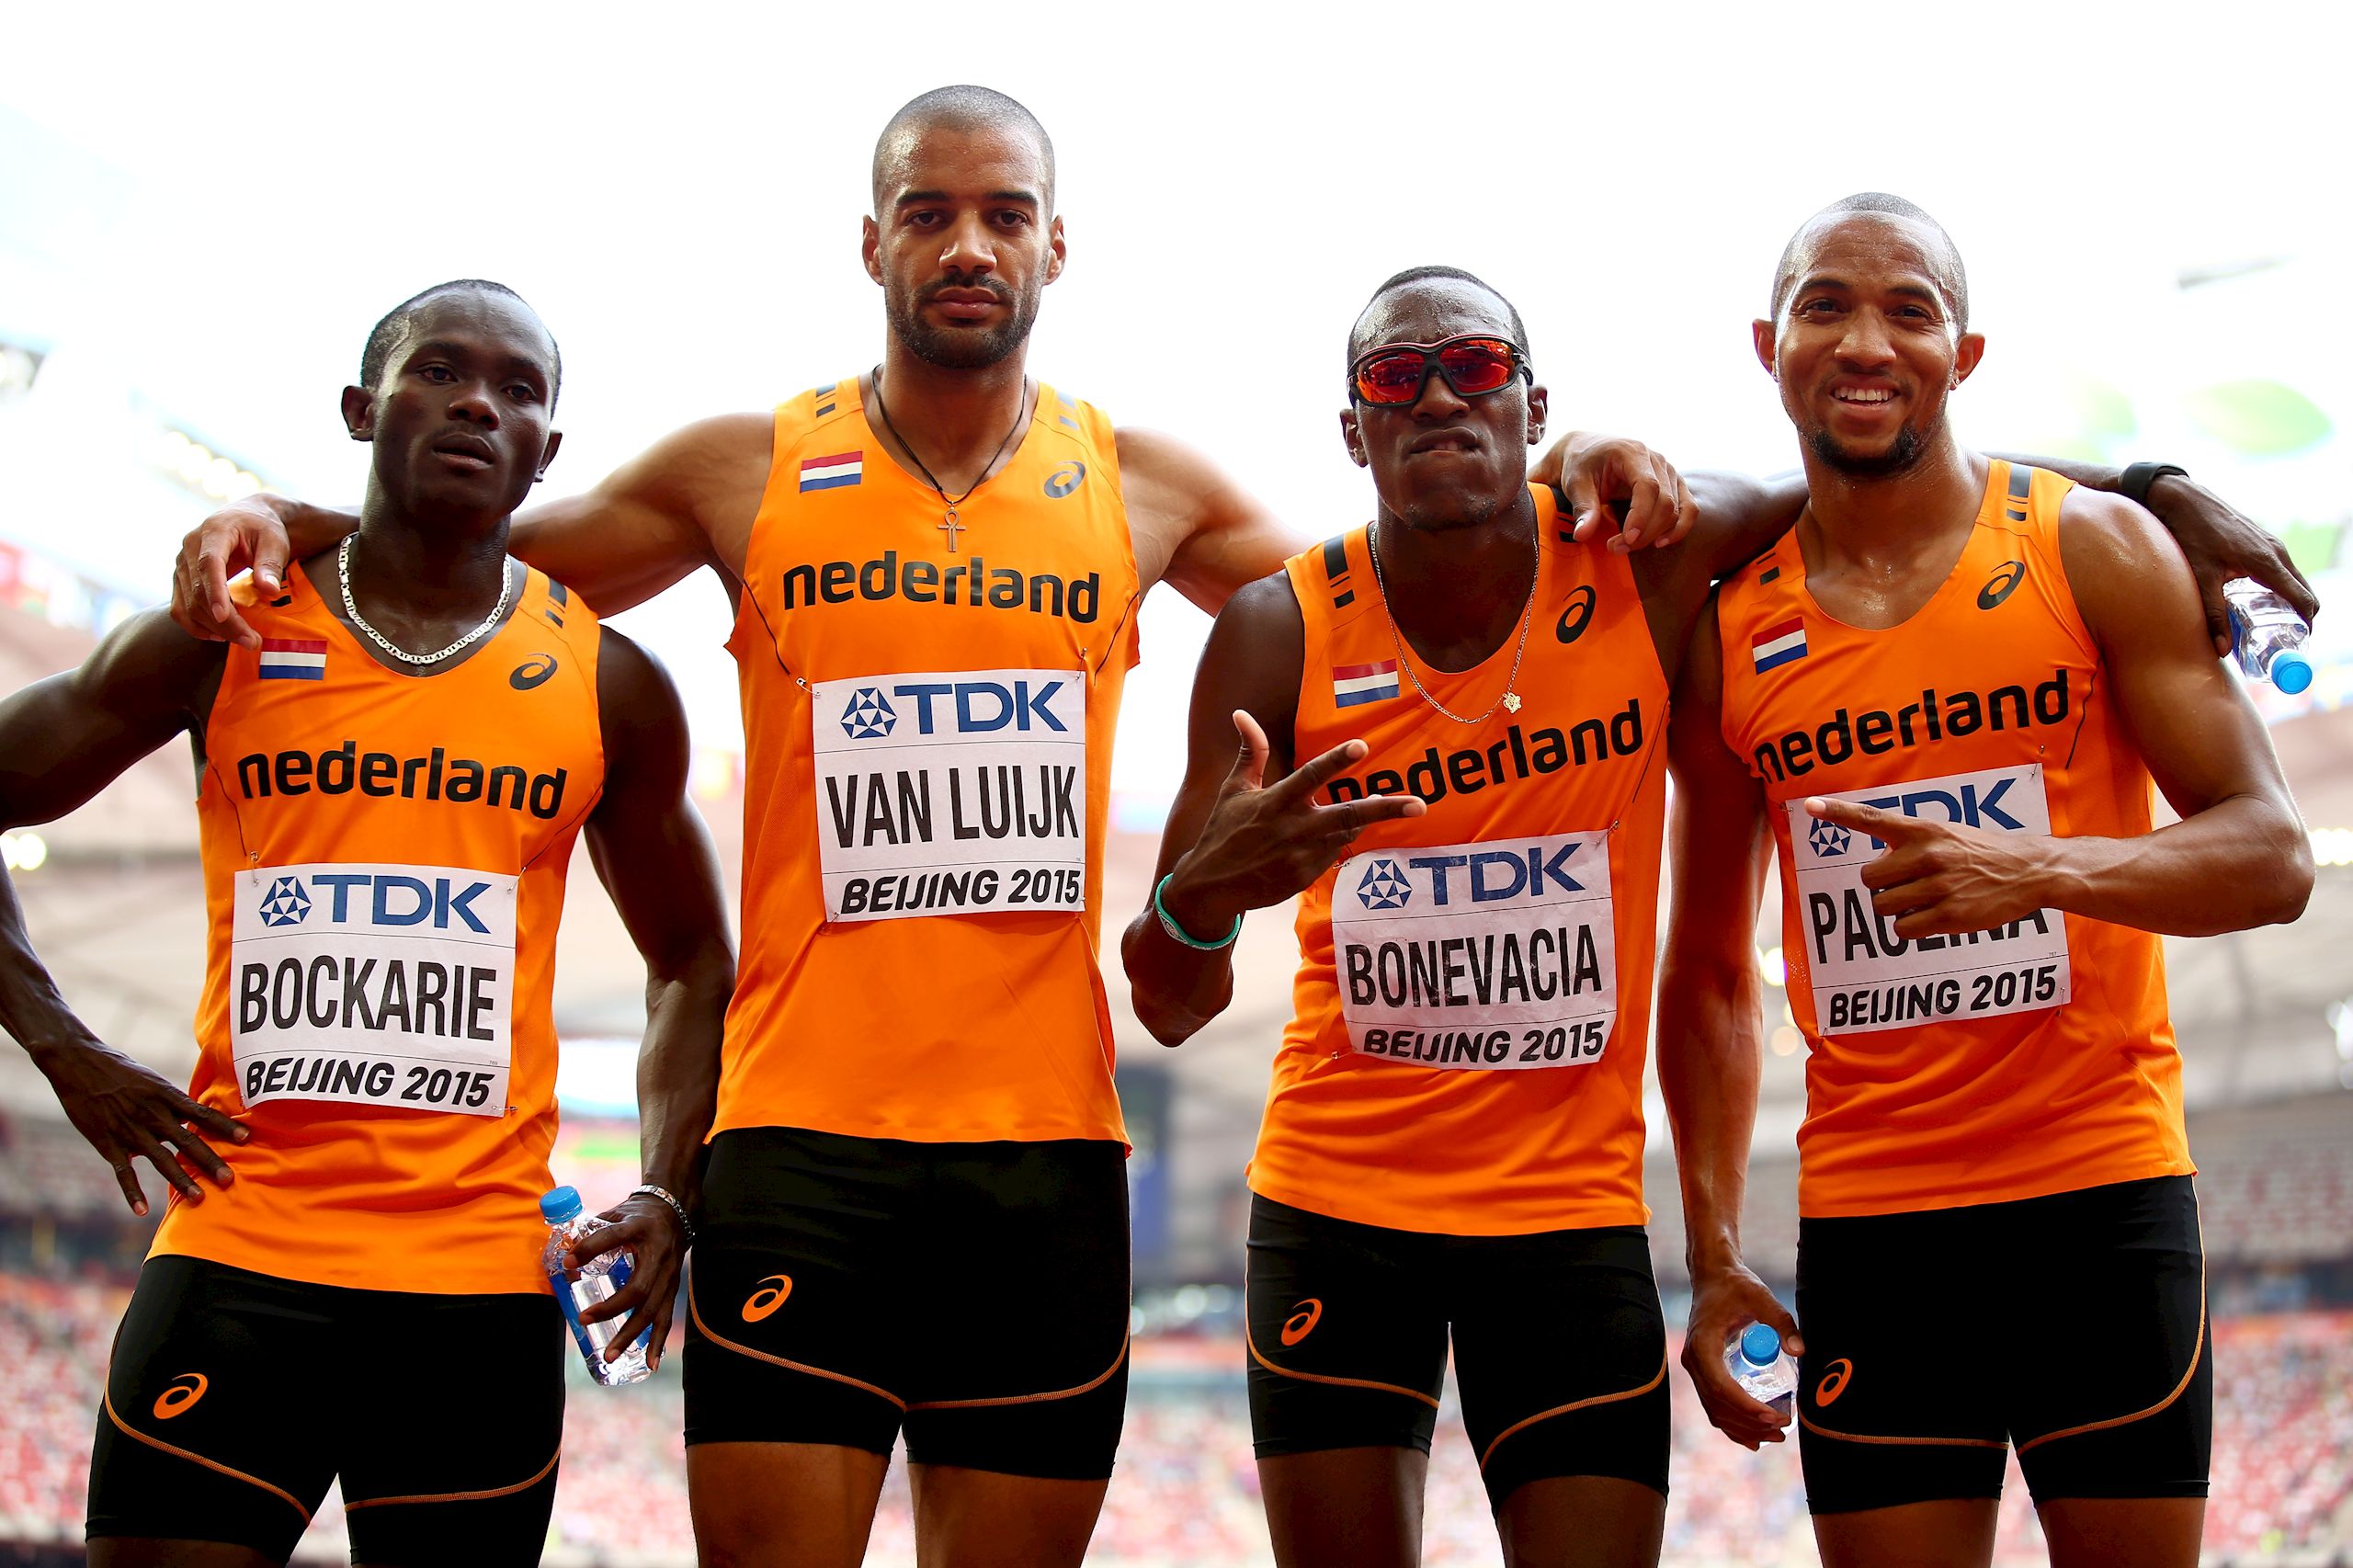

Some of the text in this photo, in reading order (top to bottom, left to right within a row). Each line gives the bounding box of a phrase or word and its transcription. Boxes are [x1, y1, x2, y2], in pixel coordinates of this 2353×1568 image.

[783, 550, 1100, 624] nederland
[893, 680, 1068, 735] TDK
[1755, 668, 2069, 784] nederland
[237, 740, 568, 820] nederland
[1326, 698, 1643, 807] nederland
[824, 765, 1080, 849] VAN LUIJK
[312, 874, 492, 935] TDK
[840, 869, 1081, 915] BEIJING 2015
[1408, 843, 1586, 906] TDK
[1808, 881, 2050, 965] PAUA
[239, 955, 496, 1041] BOCKARIE
[1345, 924, 1602, 1008] BONEVACIA
[1829, 964, 2058, 1028] BEIJING 2015
[1363, 1020, 1605, 1063] BEIJING 2015
[246, 1057, 495, 1108] BEIJING 2015
